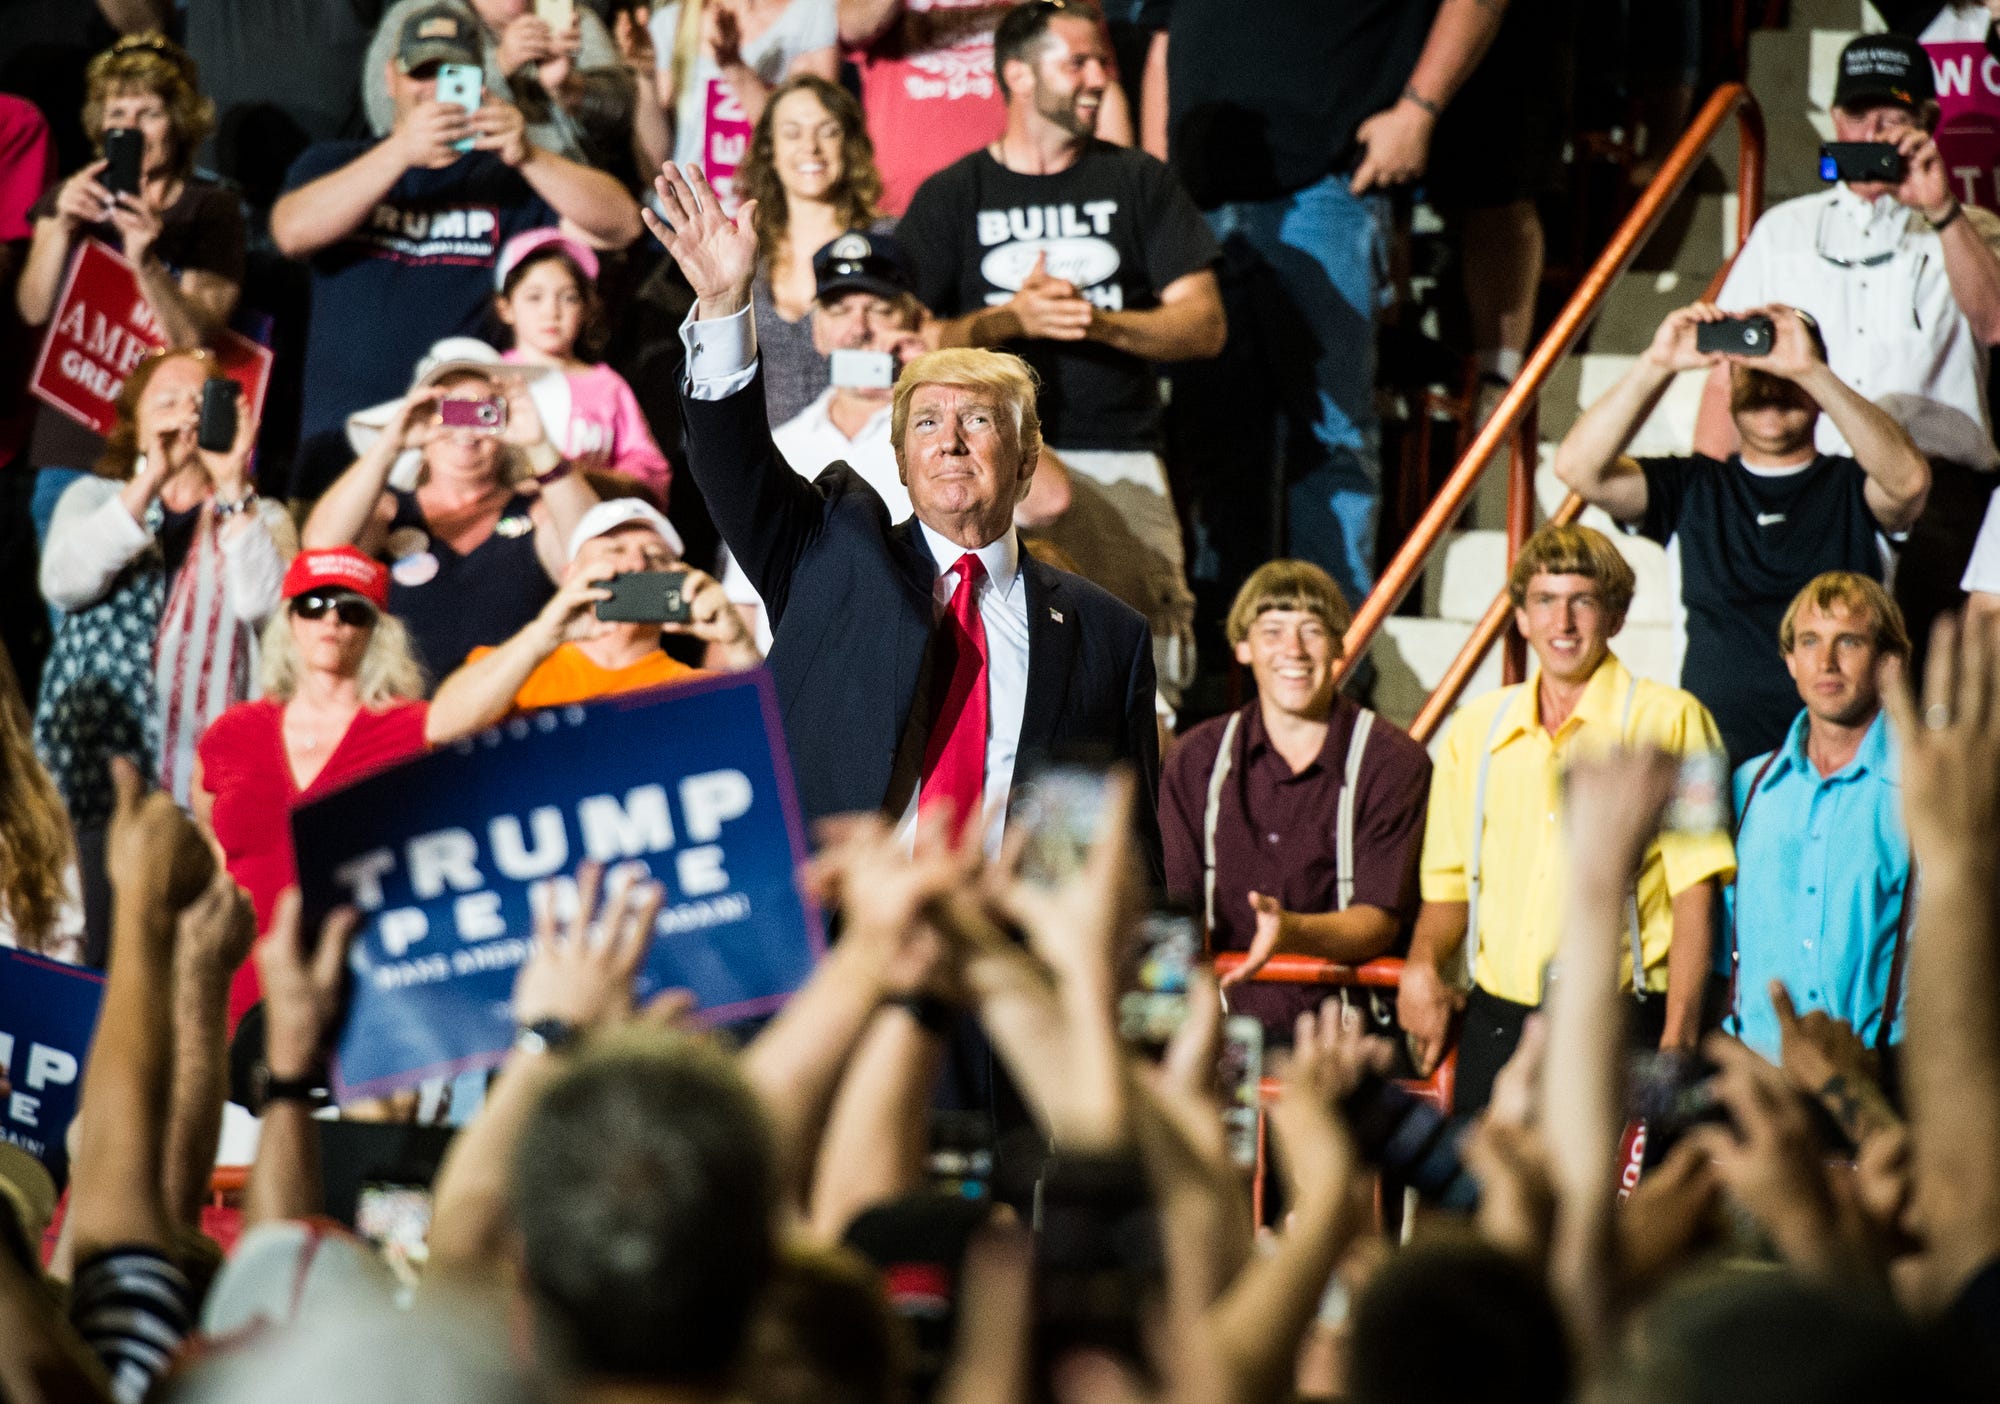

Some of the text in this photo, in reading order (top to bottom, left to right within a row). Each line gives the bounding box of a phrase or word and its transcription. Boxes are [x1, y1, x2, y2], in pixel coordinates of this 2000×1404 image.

[374, 205, 495, 240] RUMP
[976, 200, 1118, 246] BUILT
[334, 768, 754, 910] TRUMP
